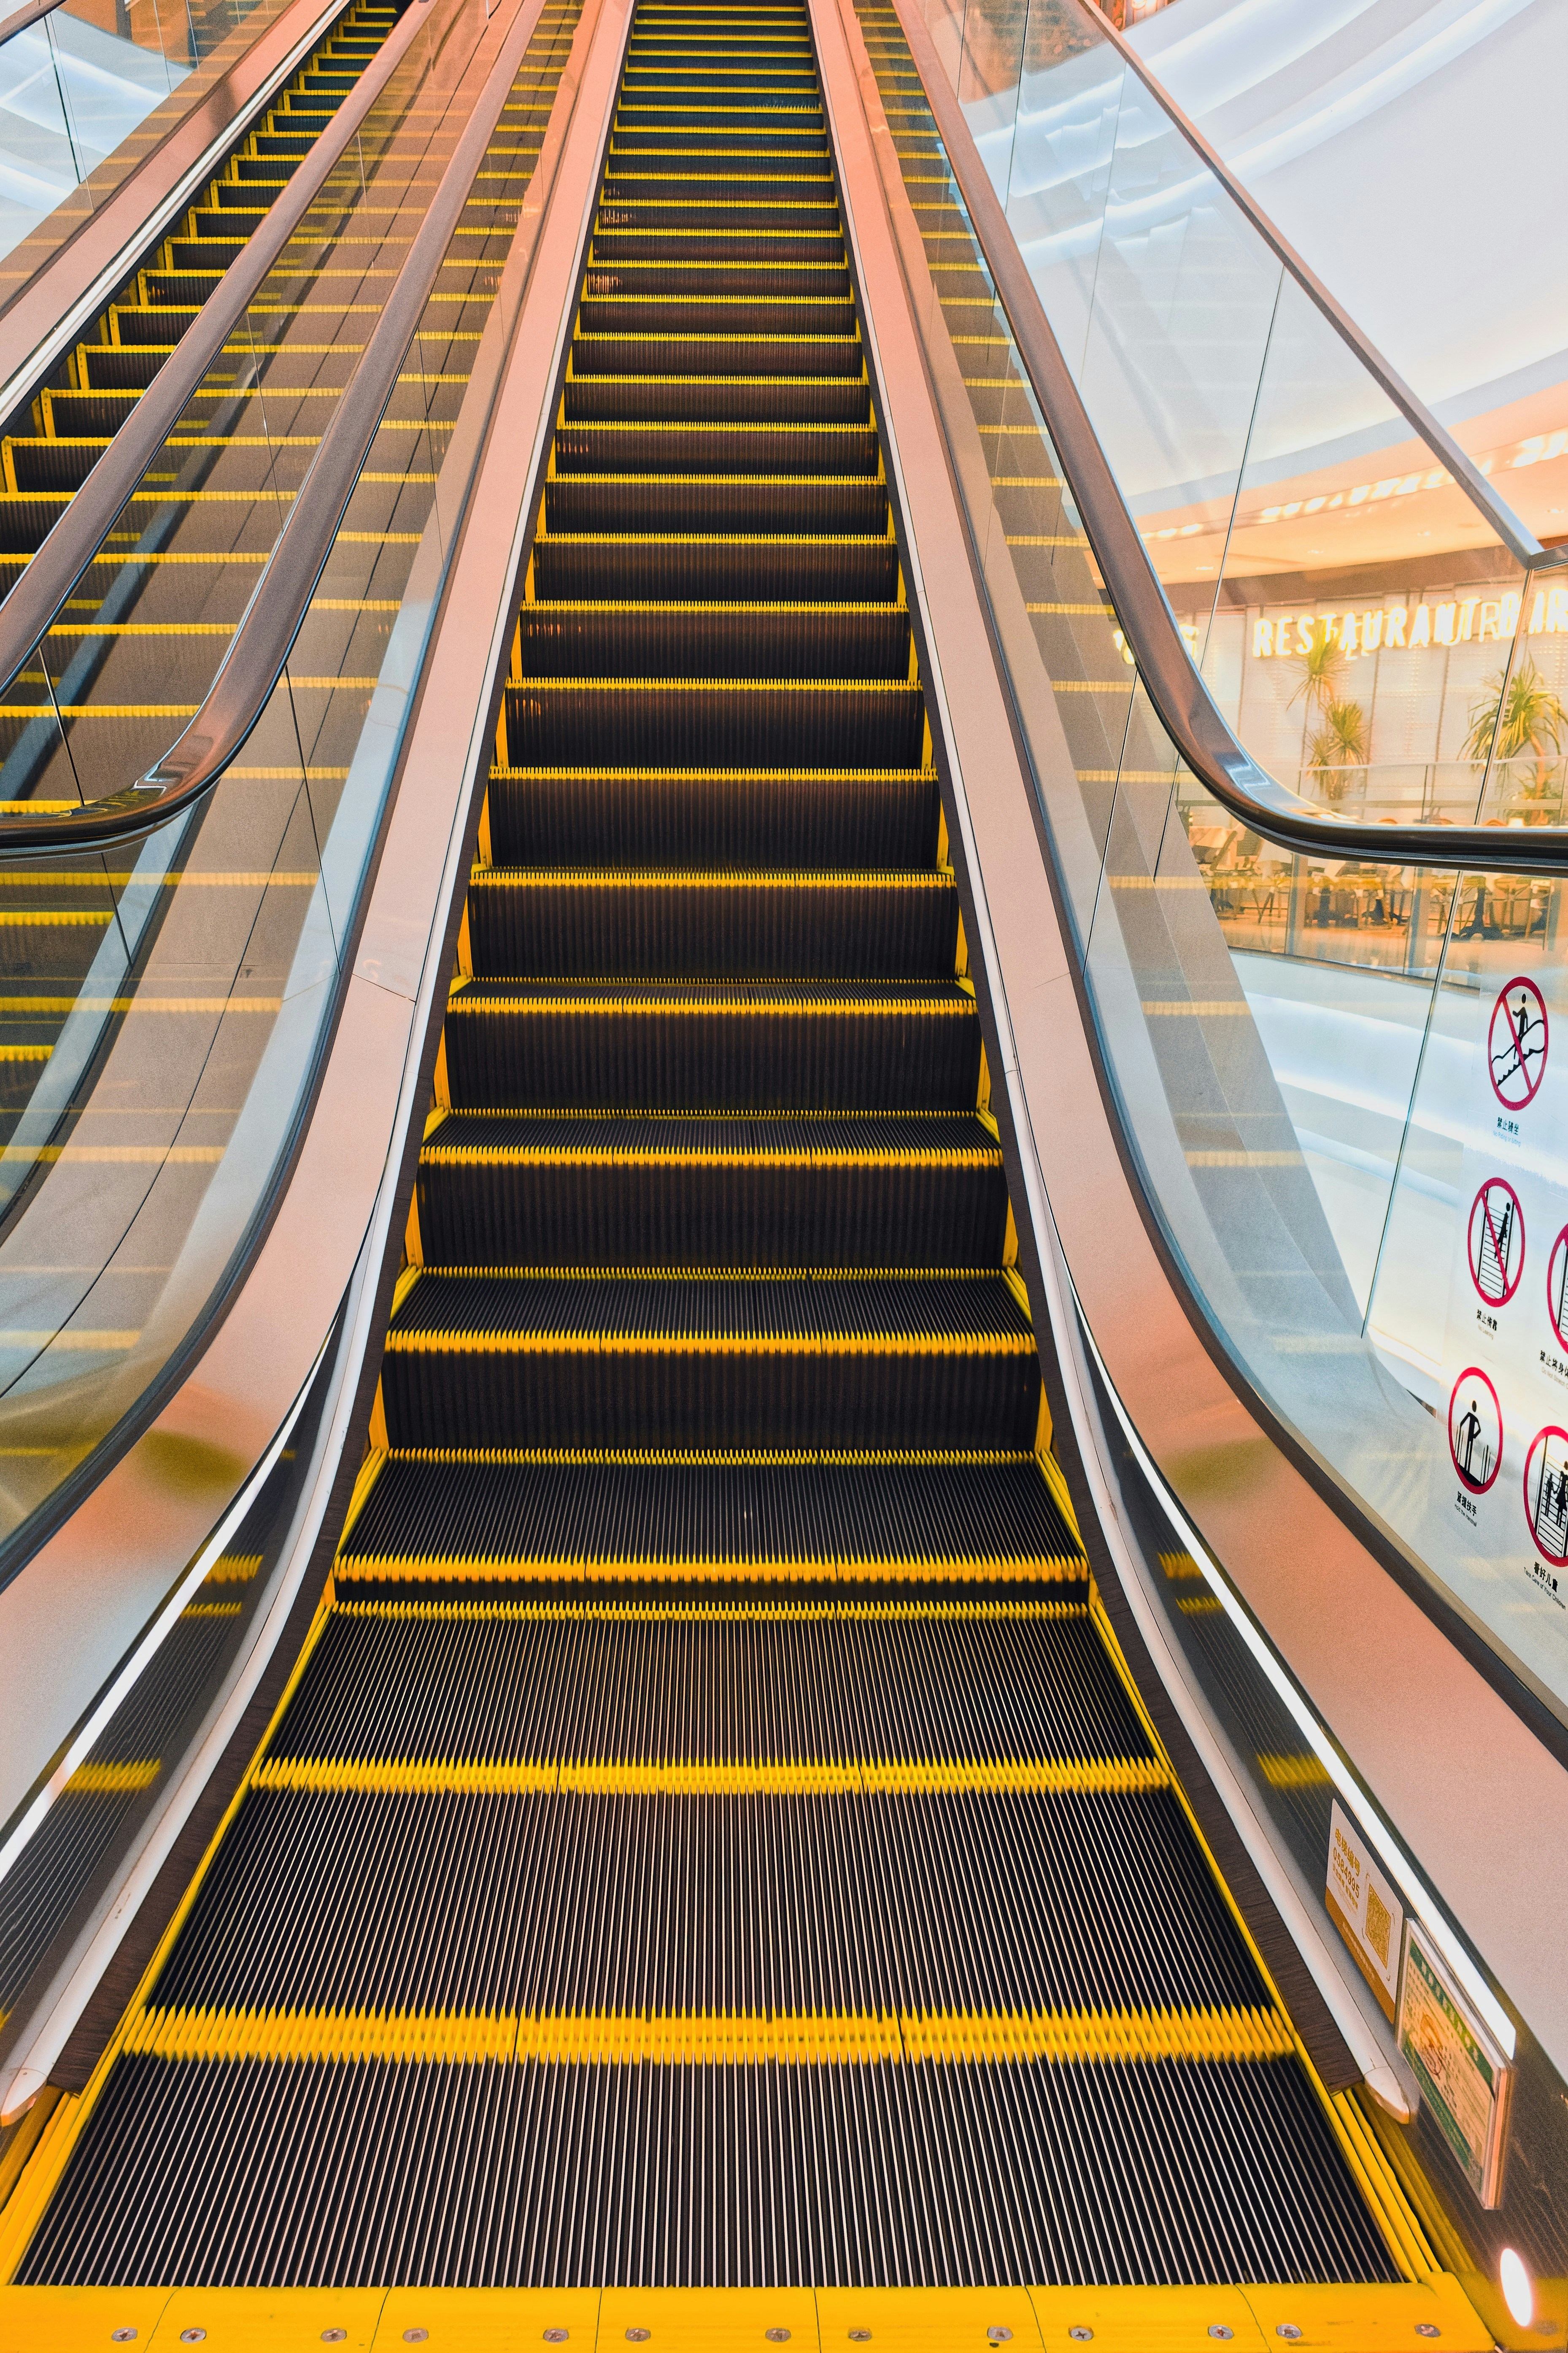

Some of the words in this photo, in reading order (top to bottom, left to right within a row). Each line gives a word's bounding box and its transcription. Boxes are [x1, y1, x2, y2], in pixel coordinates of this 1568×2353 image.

[1253, 597, 1482, 657] RESTAURANT
[1497, 1117, 1519, 1135] 禁止骑坐
[1476, 1309, 1497, 1331] 禁止倚靠
[1532, 1575, 1540, 1586] Care
[1544, 1586, 1552, 1597] Your
[1534, 1561, 1558, 1593] 看好儿童
